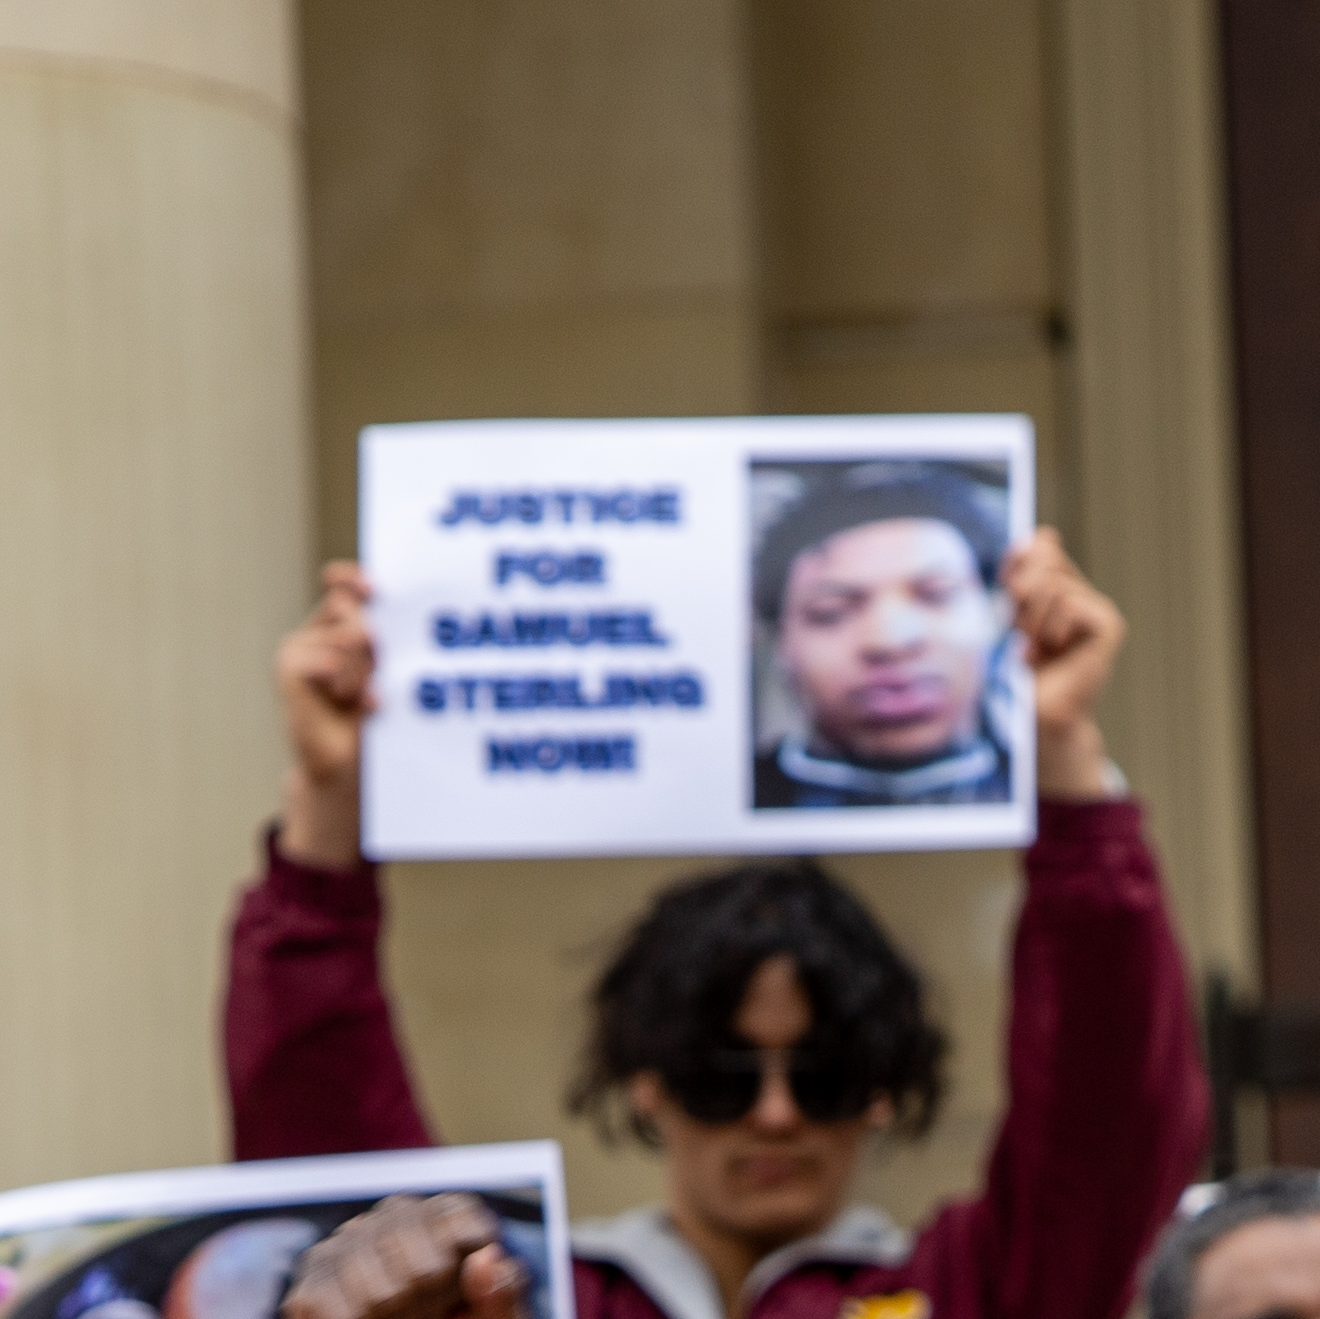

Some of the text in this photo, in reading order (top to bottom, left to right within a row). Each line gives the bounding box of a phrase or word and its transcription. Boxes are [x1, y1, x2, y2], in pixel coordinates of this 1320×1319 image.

[436, 488, 684, 528] JUSTICE
[492, 549, 609, 589] FOR
[432, 608, 672, 651] SAMUEL
[415, 668, 706, 712] STERLING
